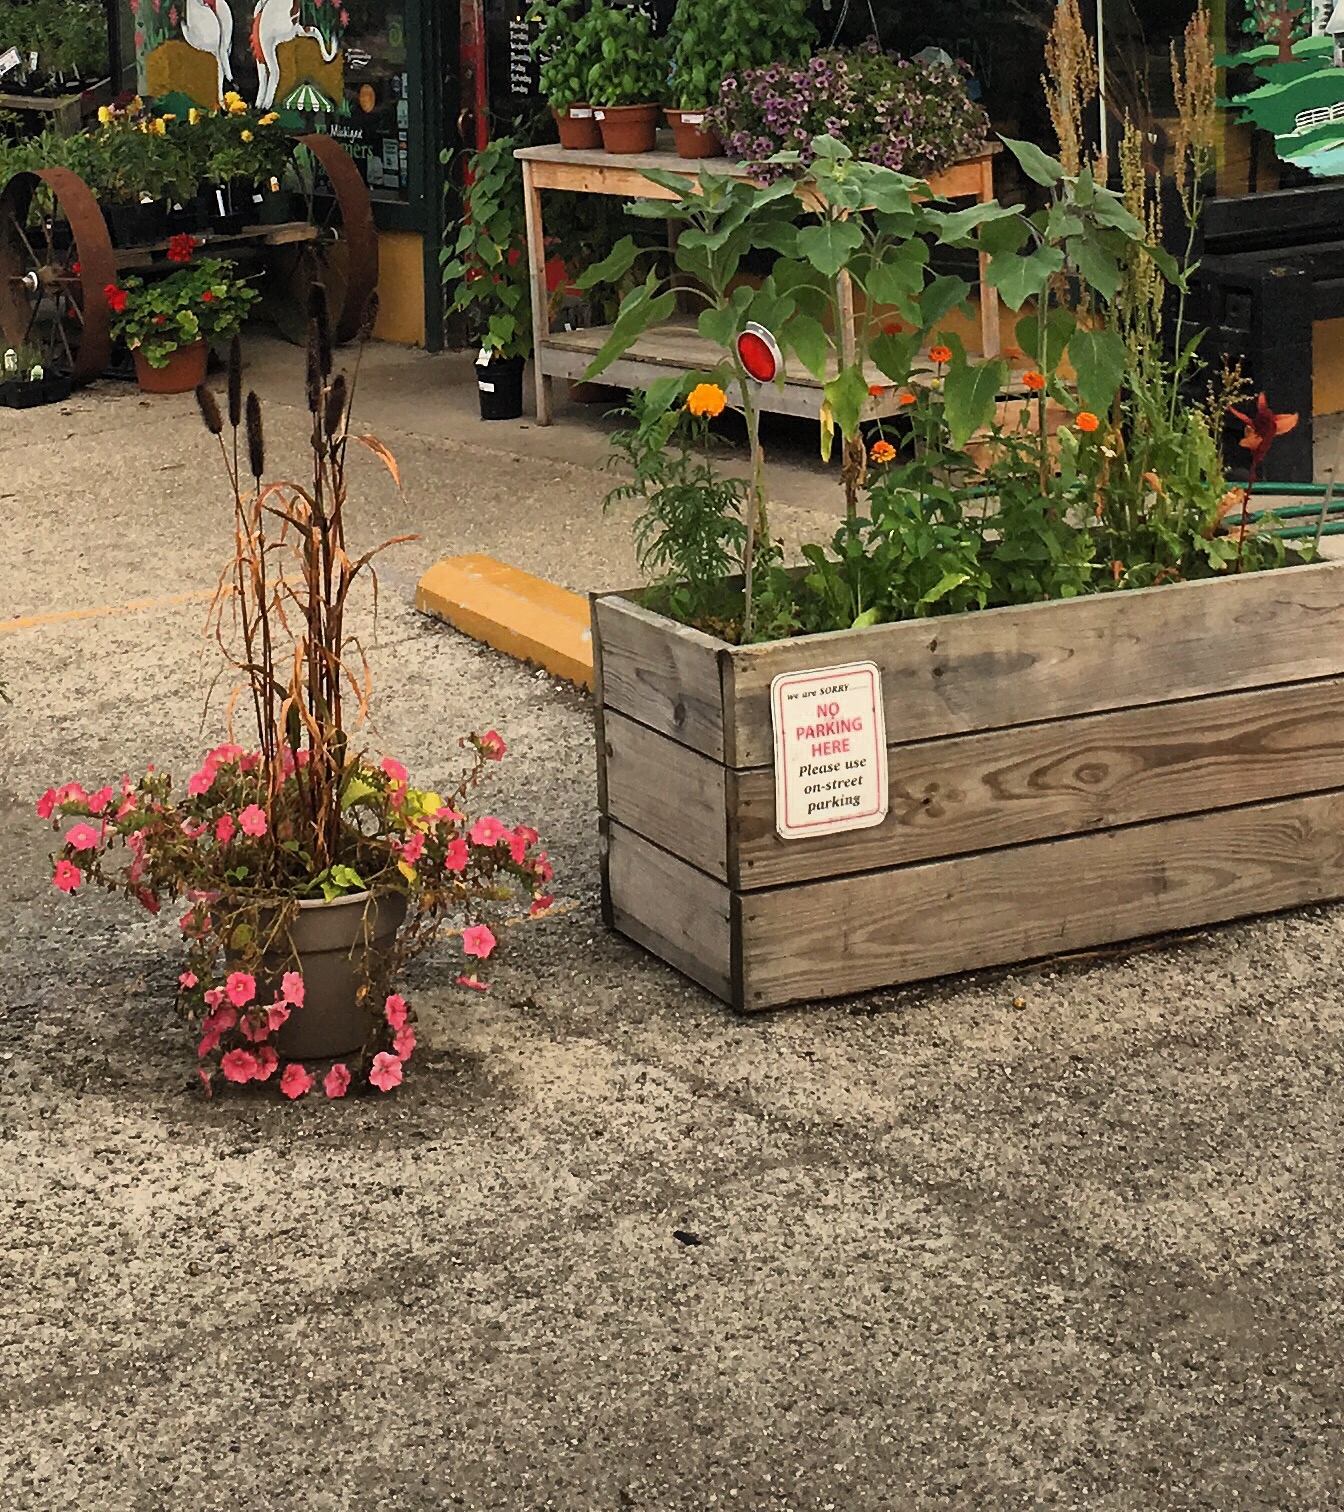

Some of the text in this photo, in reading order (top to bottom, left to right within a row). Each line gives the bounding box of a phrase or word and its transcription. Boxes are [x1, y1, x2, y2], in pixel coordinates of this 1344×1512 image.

[787, 693, 799, 701] we
[802, 690, 817, 699] are
[816, 702, 840, 719] NO
[796, 717, 863, 740] PARKING
[811, 738, 851, 757] HERE
[798, 757, 867, 778] Please use
[803, 774, 863, 795] on-street
[807, 793, 861, 815] parking
